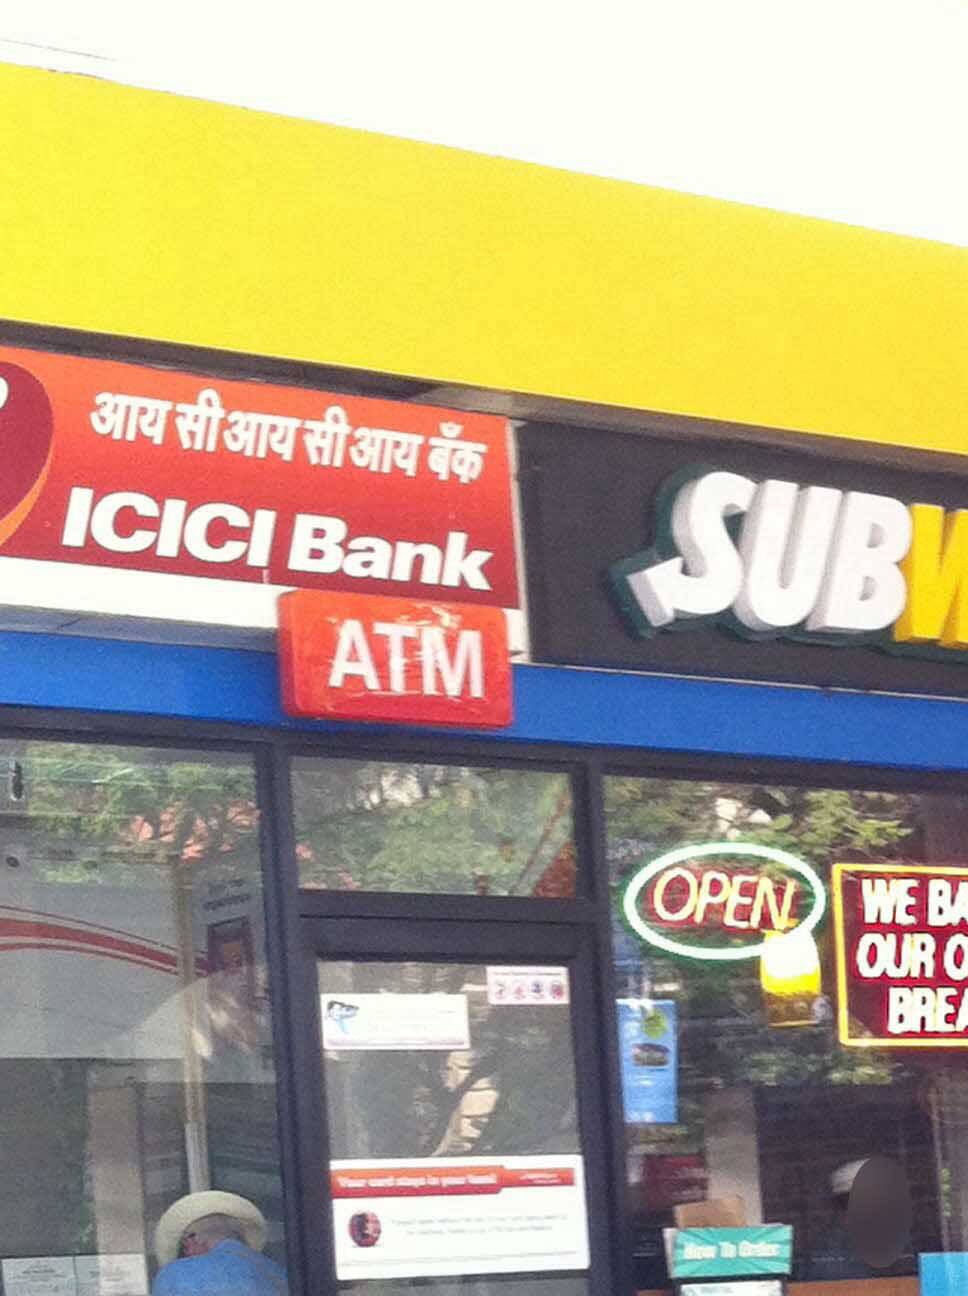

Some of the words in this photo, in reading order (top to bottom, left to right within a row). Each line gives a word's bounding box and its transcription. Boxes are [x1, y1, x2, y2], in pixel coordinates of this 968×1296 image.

[427, 422, 487, 484] बँक
[61, 486, 277, 567] ICICI
[288, 514, 494, 591] Bank
[328, 618, 485, 699] ATM
[653, 867, 797, 931] OPEN
[861, 878, 917, 925] WE
[856, 932, 936, 980] OUR
